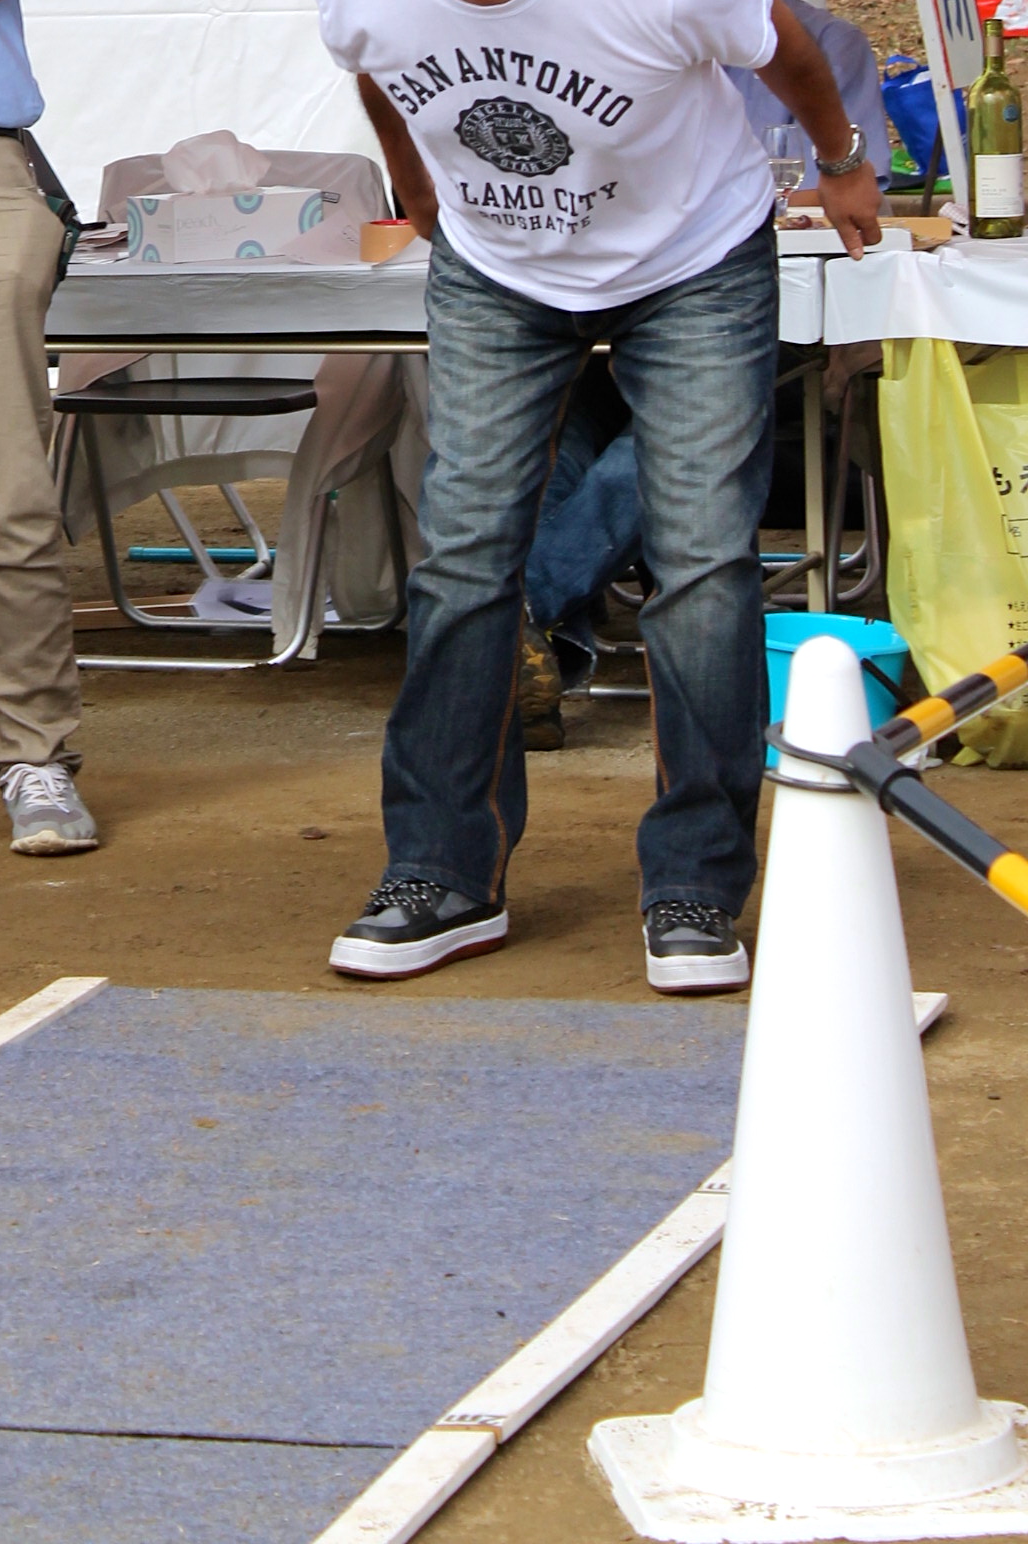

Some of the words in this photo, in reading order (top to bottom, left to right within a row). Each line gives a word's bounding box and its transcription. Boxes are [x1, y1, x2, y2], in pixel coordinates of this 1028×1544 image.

[388, 54, 455, 116] SAN
[454, 46, 634, 127] ANTONIO
[456, 182, 545, 210] LAMO
[553, 181, 619, 217] CITY
